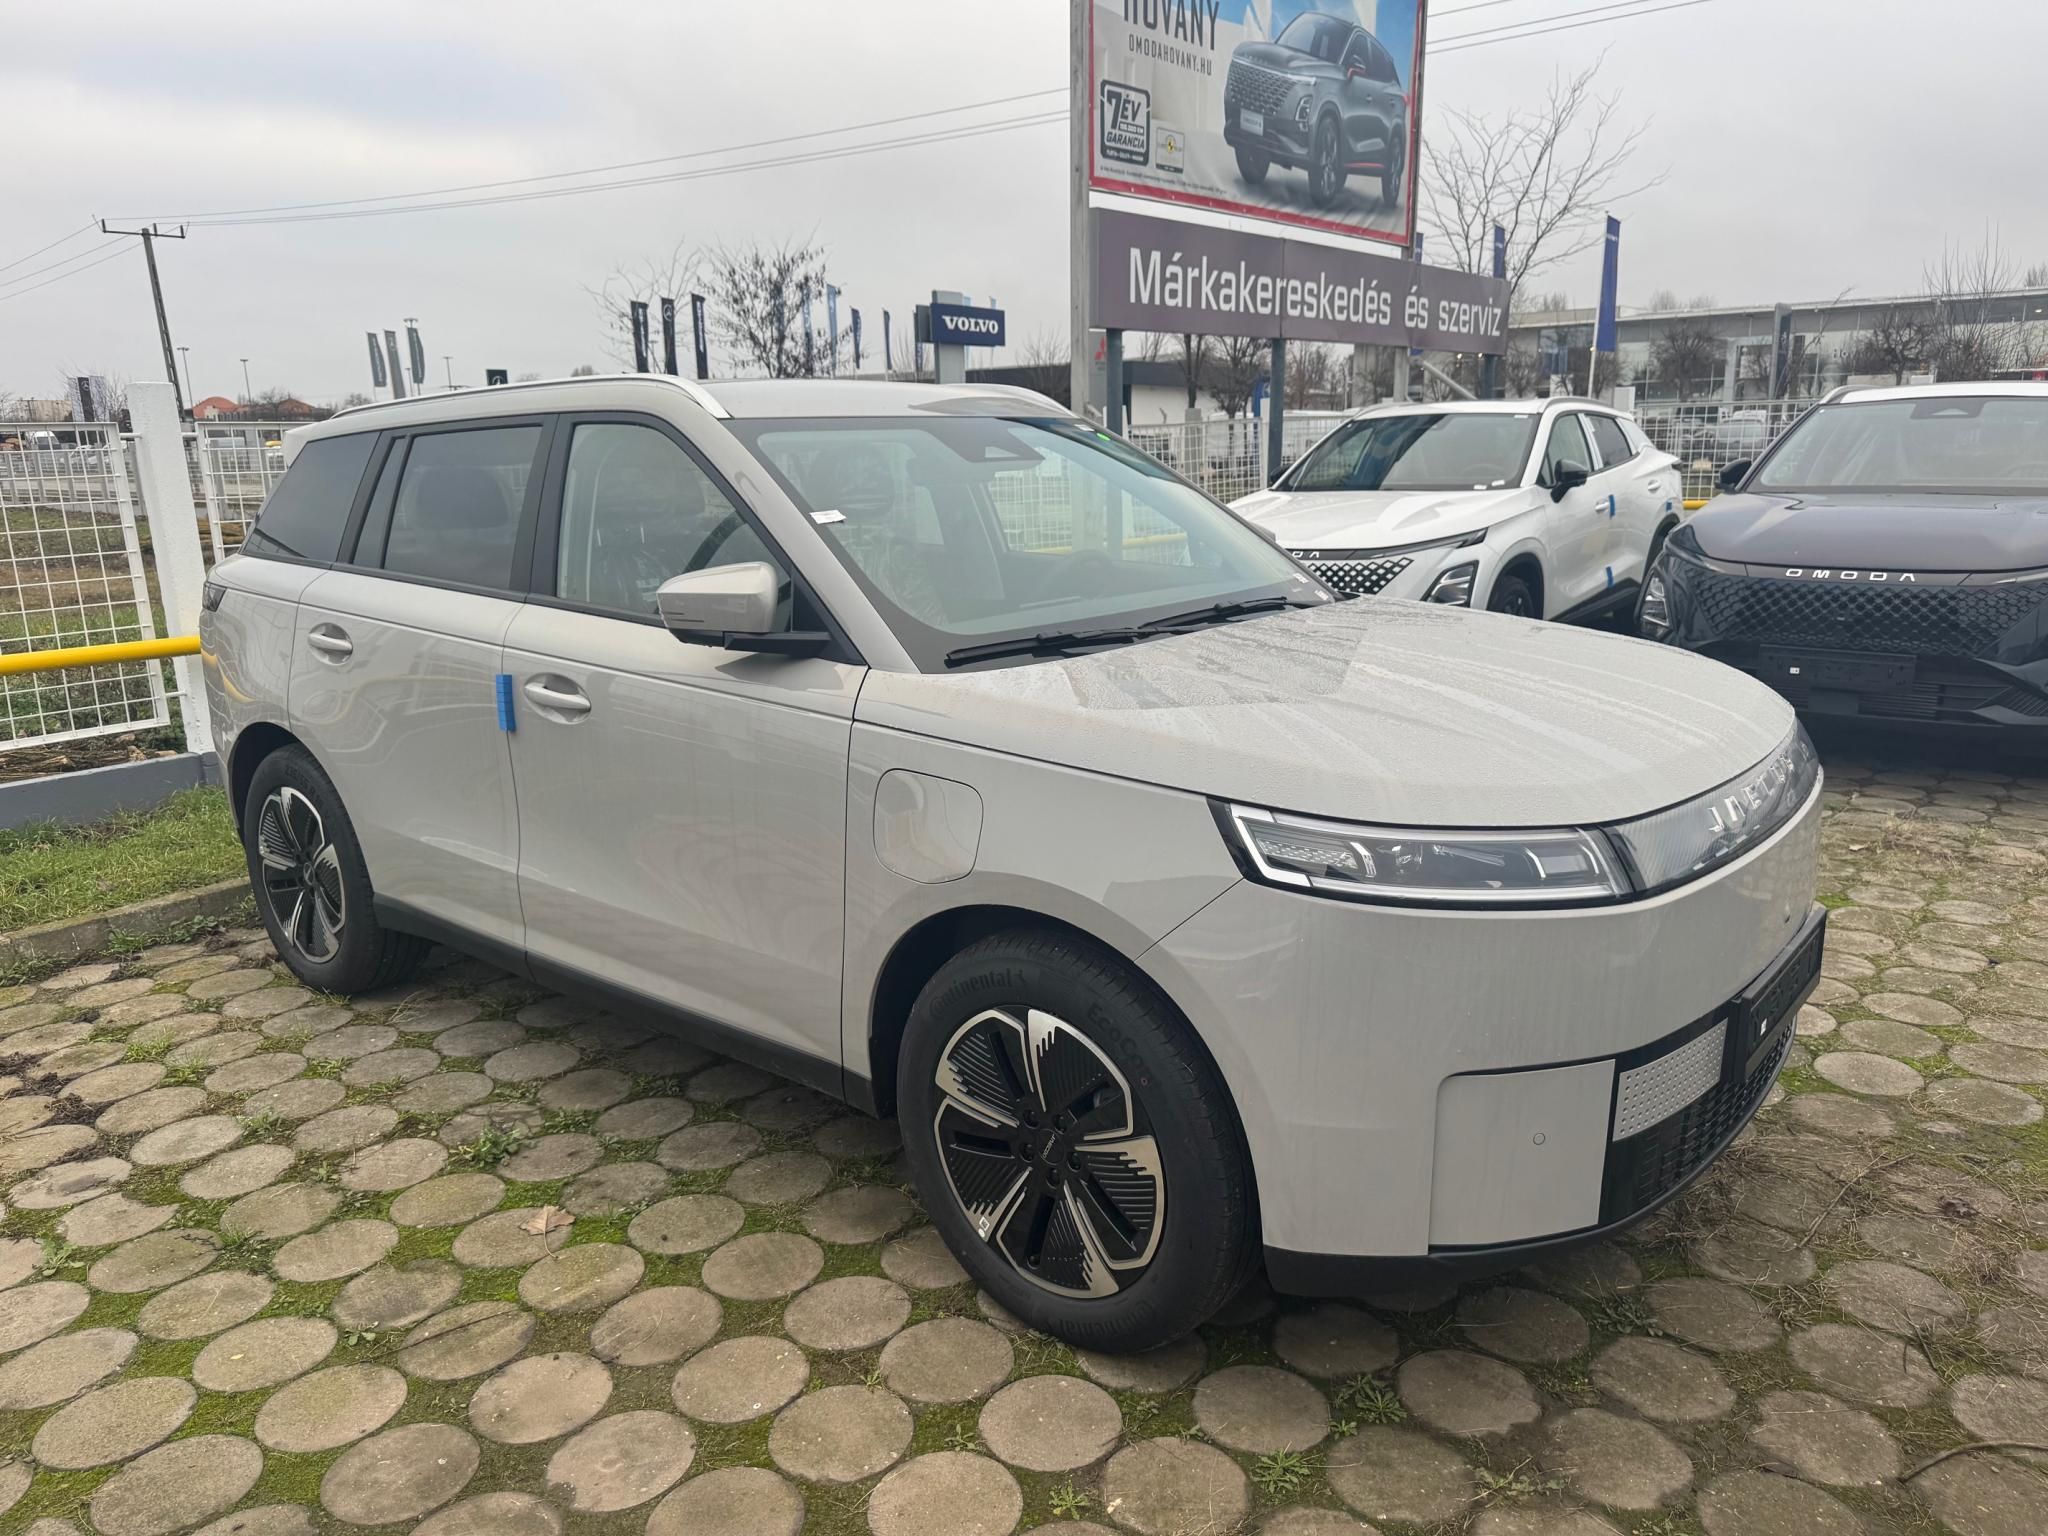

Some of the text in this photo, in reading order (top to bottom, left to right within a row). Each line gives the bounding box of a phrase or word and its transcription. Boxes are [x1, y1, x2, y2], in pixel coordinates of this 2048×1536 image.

[1128, 33, 1212, 76] OMODAHOVANY.HU
[1107, 89, 1121, 130] 7
[1106, 131, 1145, 150] GARANCIA
[1130, 247, 1502, 336] Márkakereskedés és szerviz
[941, 315, 999, 334] VOLVO
[1785, 568, 1915, 582] OMODA
